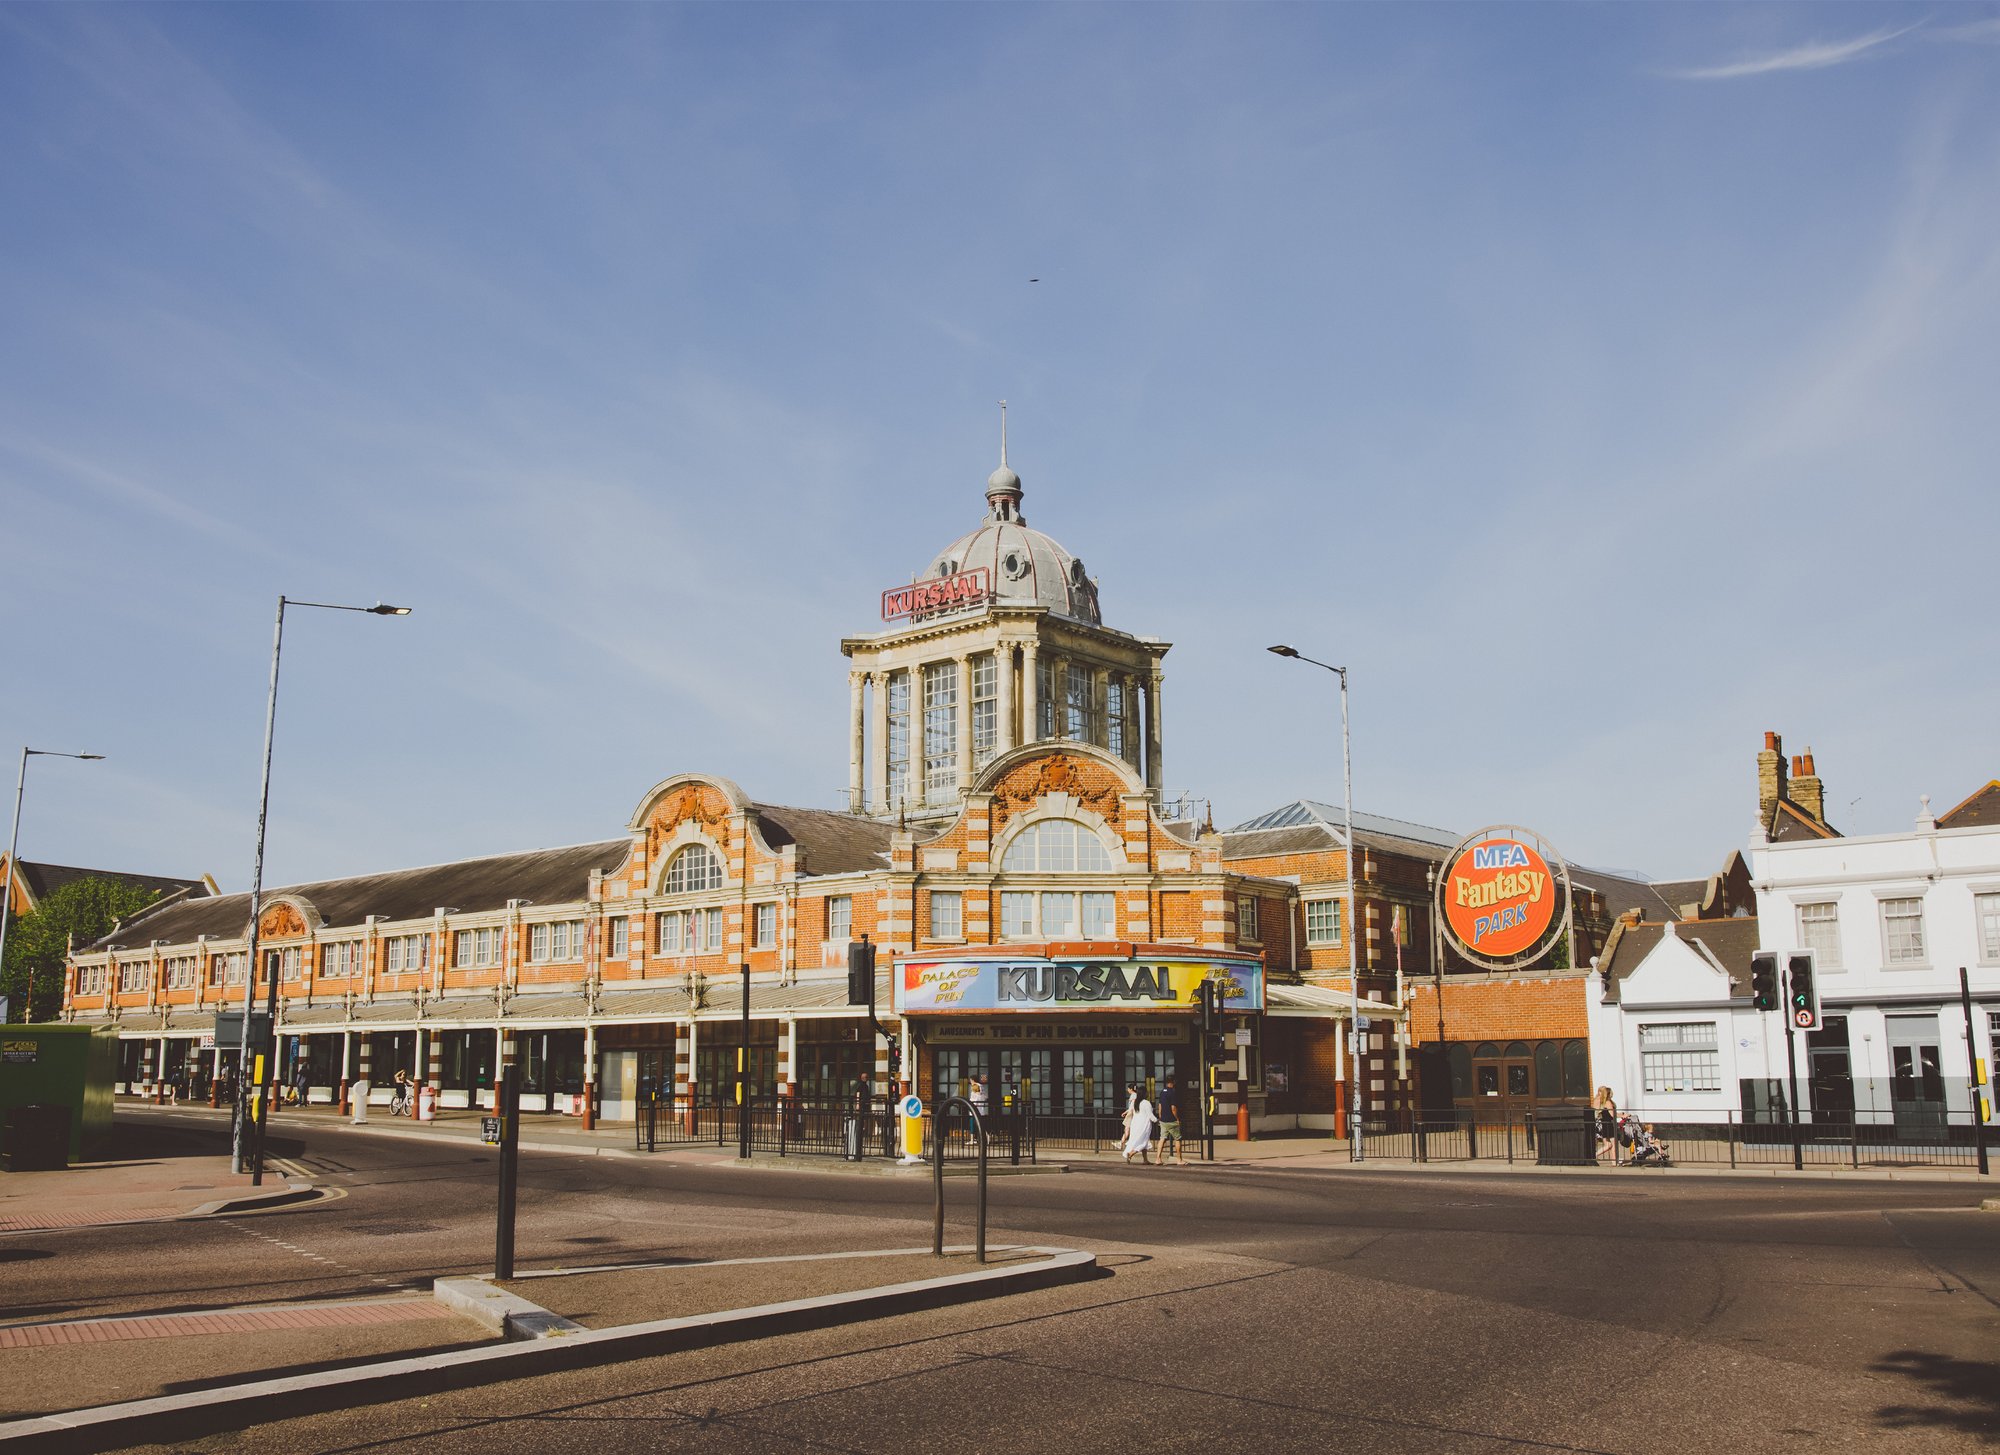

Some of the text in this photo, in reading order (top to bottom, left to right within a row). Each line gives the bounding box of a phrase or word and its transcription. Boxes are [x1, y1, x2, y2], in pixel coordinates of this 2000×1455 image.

[888, 575, 982, 615] KURSAAL
[1474, 845, 1529, 868] MFA
[1455, 870, 1545, 908] Fantasy
[1474, 902, 1529, 944] PARK
[921, 967, 979, 984] PALACE
[998, 967, 1176, 1001] KURSAAL
[1206, 968, 1230, 978] THE
[939, 981, 960, 991] OF
[939, 1025, 1177, 1038] AMUSEMENTS TEN PIN BOWLING SPORTS BAR
